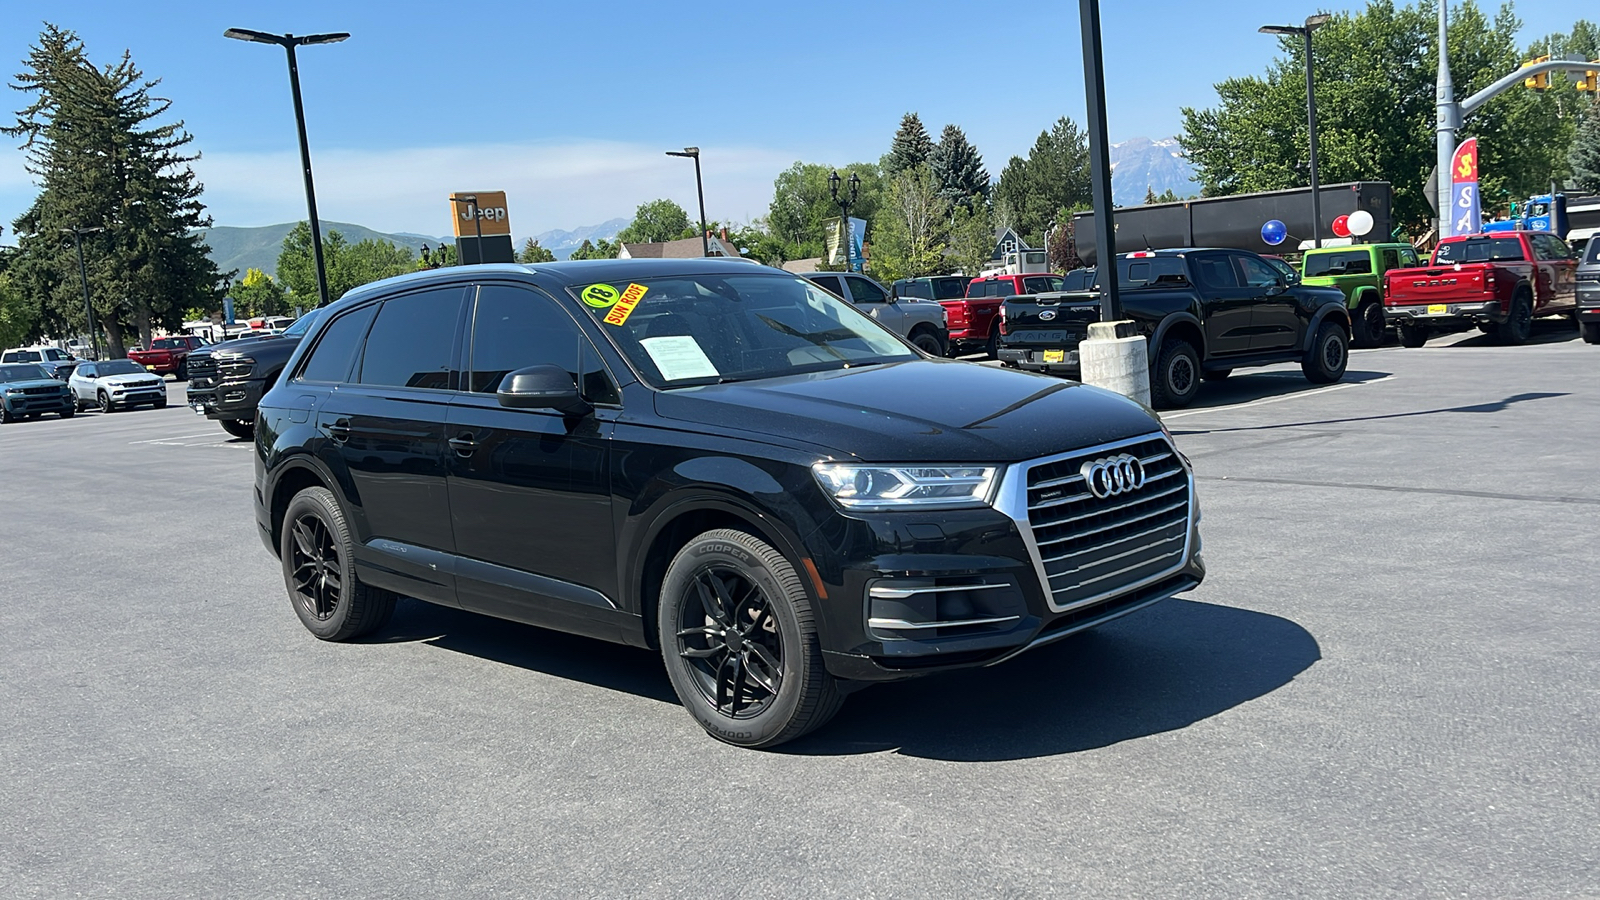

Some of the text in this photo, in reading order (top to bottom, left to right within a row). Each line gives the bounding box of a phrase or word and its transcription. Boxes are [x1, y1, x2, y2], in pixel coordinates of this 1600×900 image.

[461, 204, 506, 222] Jeep
[1456, 186, 1472, 234] SA
[587, 287, 613, 303] 18
[607, 285, 644, 324] SUN ROOF
[699, 544, 749, 562] COOPER
[703, 719, 752, 738] COOPER
